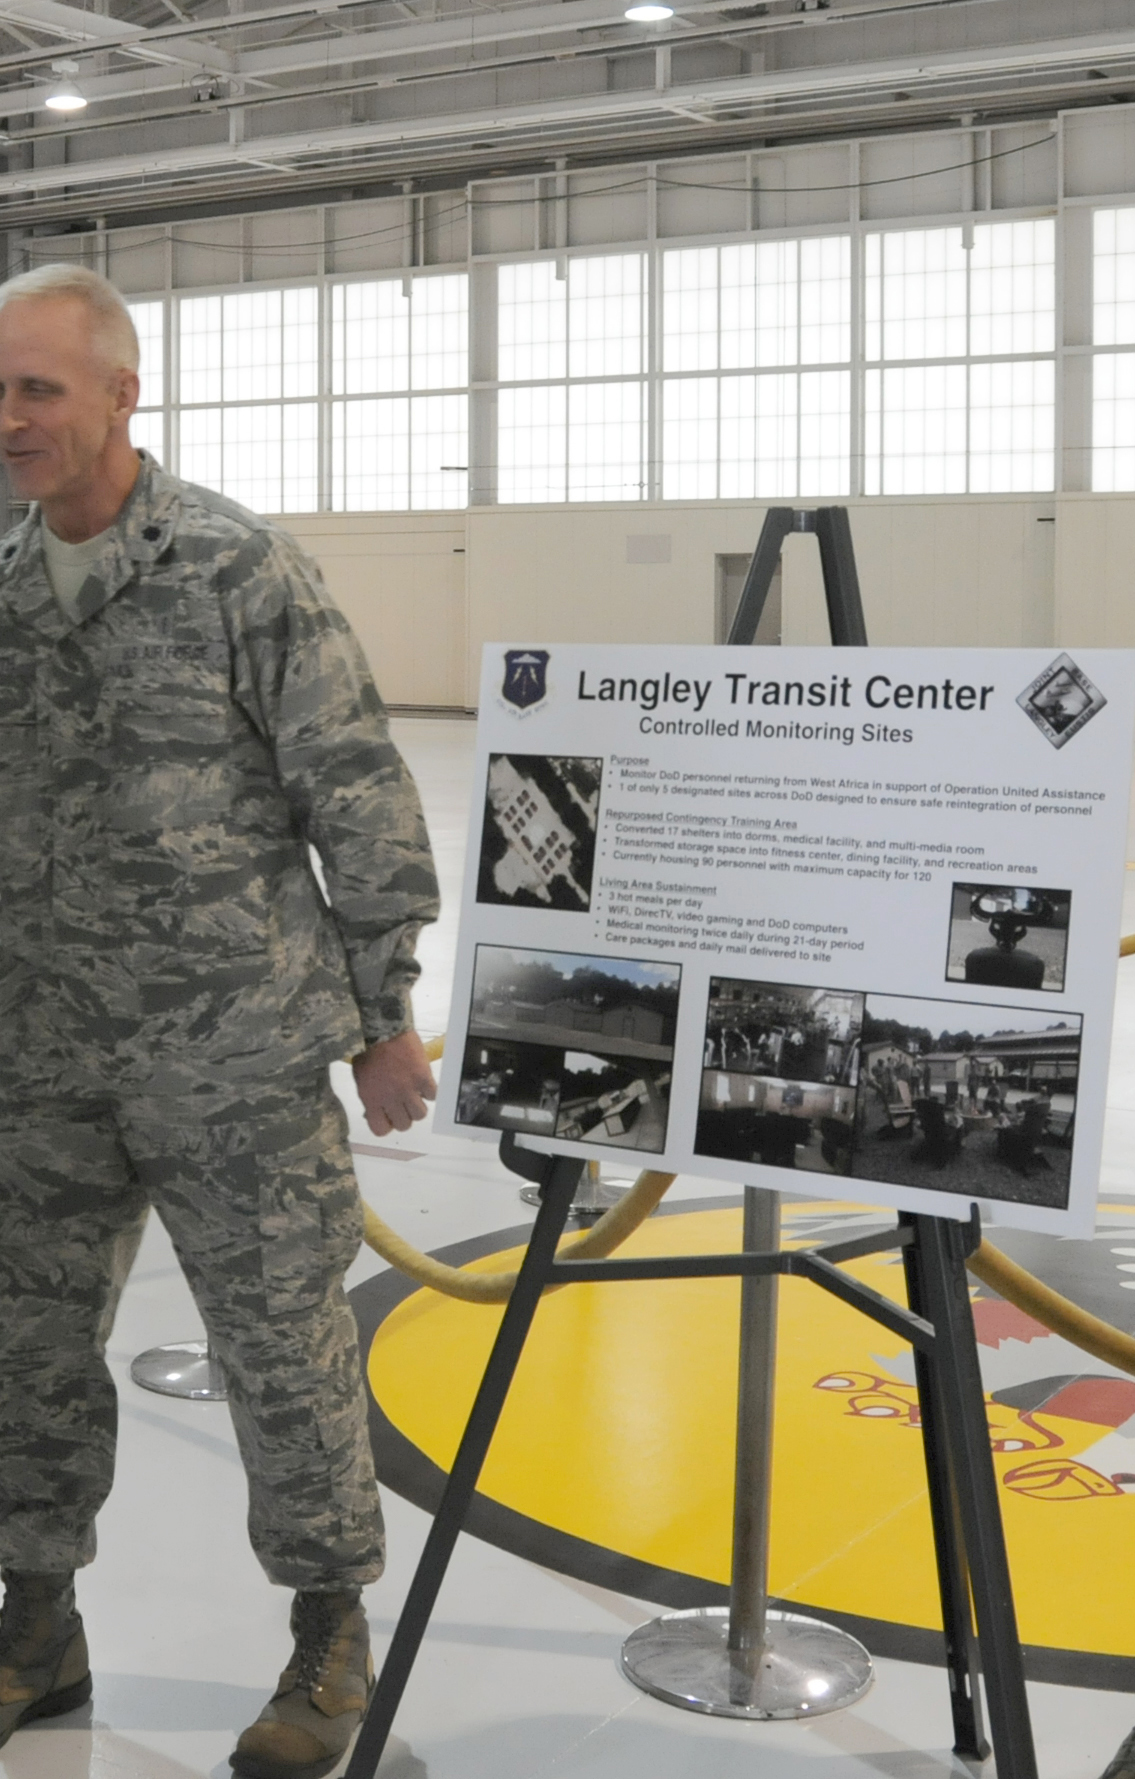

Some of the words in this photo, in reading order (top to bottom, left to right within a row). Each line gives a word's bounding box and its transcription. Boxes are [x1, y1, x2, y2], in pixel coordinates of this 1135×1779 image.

[578, 670, 712, 711] Langley
[725, 673, 852, 707] Transit
[865, 675, 995, 711] Center
[639, 716, 739, 737] Controlled
[746, 720, 854, 746] Monitoring
[861, 722, 913, 743] Sites
[610, 754, 649, 768] Purpose
[619, 768, 656, 780] Monitor
[659, 770, 680, 781] DoD
[682, 771, 731, 786] personnel
[734, 774, 780, 788] returning
[783, 776, 807, 787] from
[810, 777, 835, 788] West
[838, 778, 869, 790] Africa
[872, 780, 882, 790] in
[885, 781, 926, 795] support
[930, 783, 940, 793] of
[944, 783, 998, 798] Operation
[1002, 786, 1039, 797] United
[1042, 788, 1105, 800] Assistance
[619, 782, 624, 792] 1
[626, 782, 637, 793] of
[638, 783, 660, 796] only
[670, 785, 725, 800] designated
[727, 787, 751, 798] sites
[754, 791, 788, 800] across
[791, 790, 813, 801] DoD
[816, 792, 863, 806] designed
[866, 795, 877, 805] to
[880, 797, 917, 806] ensure
[920, 797, 942, 808] safe
[946, 798, 1016, 814] reintegration
[1020, 802, 1031, 812] of
[1034, 803, 1092, 818] personnel
[605, 809, 663, 824] Repurposed
[665, 812, 727, 827] Contingency
[731, 815, 771, 830] Training
[774, 818, 797, 828] Area
[614, 823, 665, 835] Converted
[667, 826, 678, 836] 17
[680, 826, 720, 839] shelters
[722, 829, 742, 840] into
[783, 833, 823, 845] medical
[866, 838, 886, 849] and
[889, 839, 952, 852] multi-media
[956, 845, 984, 854] room
[612, 849, 657, 865] Currently
[659, 852, 699, 868] housing
[701, 856, 714, 866] 90
[716, 856, 766, 872] personnel
[769, 860, 790, 872] with
[793, 862, 844, 875] maximum
[847, 866, 891, 881] capacity
[894, 869, 909, 880] for
[914, 870, 931, 881] 120
[614, 836, 675, 849] Transformed
[677, 840, 714, 855] storage
[716, 845, 746, 857] space
[749, 845, 768, 856] into
[771, 846, 805, 858] fitness
[846, 851, 880, 866] dining
[924, 856, 944, 868] and
[948, 858, 1003, 871] recreation
[1007, 864, 1037, 874] areas
[599, 876, 629, 891] Living
[630, 879, 653, 890] Area
[655, 880, 716, 894] Sustainment
[609, 890, 615, 901] 3
[617, 891, 633, 902] hot
[635, 892, 664, 904] meals
[666, 896, 682, 907] per
[685, 895, 702, 909] day
[606, 917, 643, 930] Medical
[645, 921, 699, 938] monitoring
[701, 926, 727, 938] twice
[730, 928, 754, 943] daily
[757, 931, 790, 946] during
[793, 934, 827, 949] 21-day
[830, 937, 864, 953] period
[676, 910, 704, 922] video
[706, 912, 743, 928] gaming
[746, 916, 765, 927] and
[768, 917, 790, 929] DoD
[793, 920, 848, 936] computers
[604, 931, 628, 943] Care
[629, 933, 676, 950] packages
[678, 938, 697, 949] and
[699, 940, 723, 954] daily
[726, 942, 747, 954] mail
[749, 944, 796, 958] delivered
[799, 949, 809, 960] to
[813, 950, 831, 962] site
